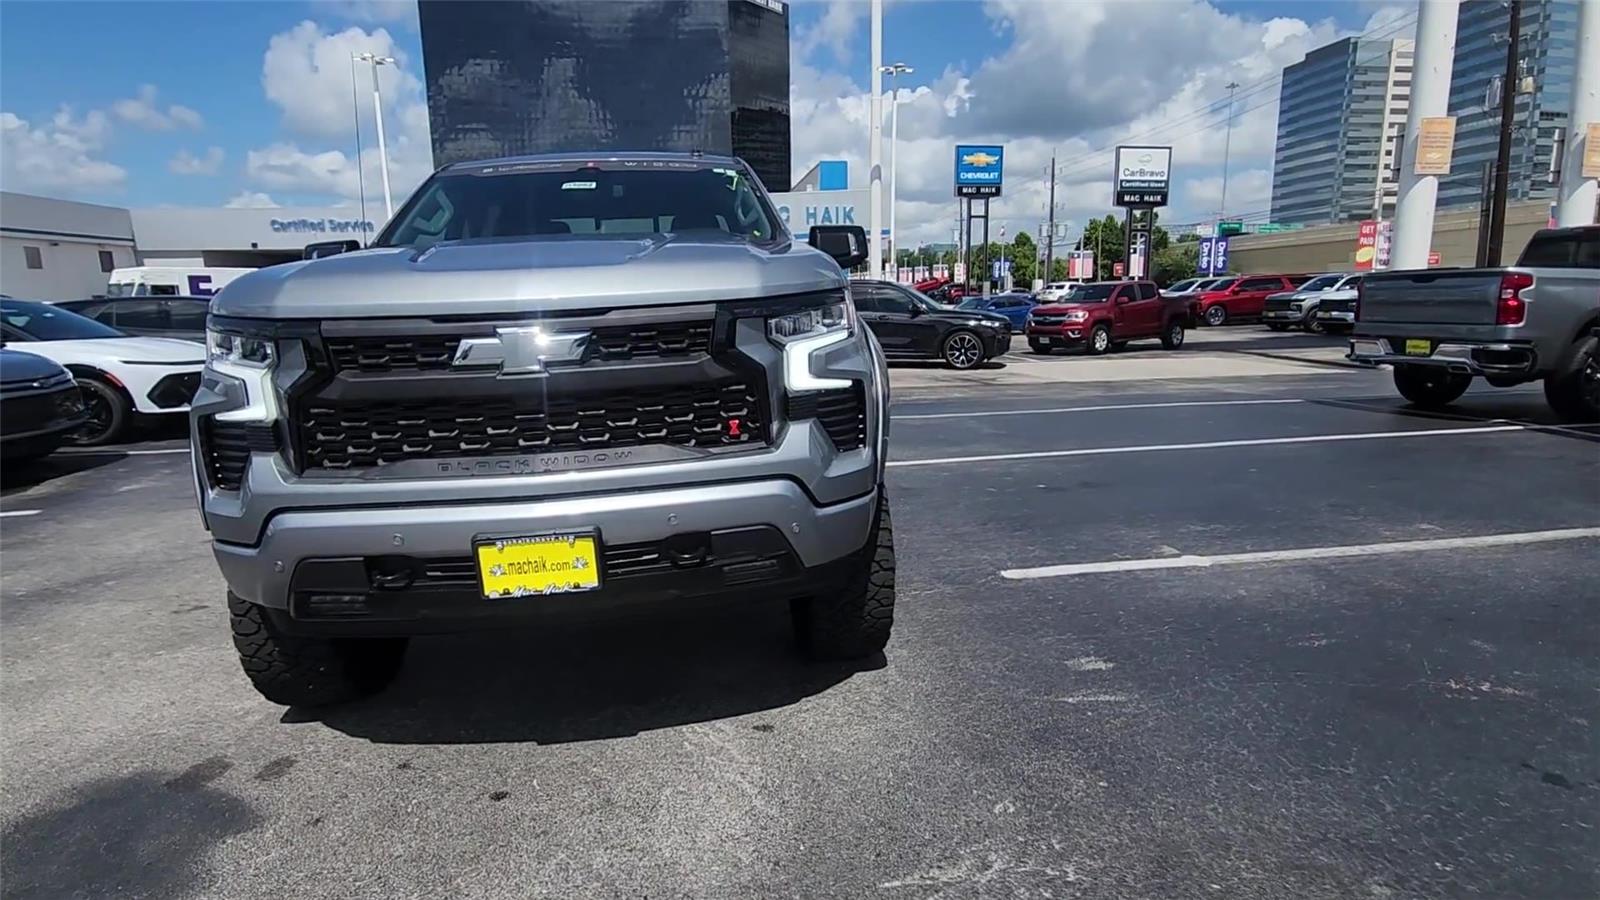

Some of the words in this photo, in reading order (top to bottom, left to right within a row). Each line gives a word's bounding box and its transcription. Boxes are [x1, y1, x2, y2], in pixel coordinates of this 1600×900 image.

[1123, 168, 1166, 177] CarBravo
[1123, 194, 1140, 202] MAC
[1143, 194, 1162, 202] HAIK
[805, 206, 855, 225] HAIK
[270, 219, 326, 233] Certified
[328, 219, 375, 233] Service
[1361, 225, 1375, 234] GET
[1359, 236, 1374, 245] PAID
[437, 458, 531, 473] BLACK
[540, 451, 633, 467] WIDOW
[507, 556, 571, 575] machaik.com
[512, 584, 538, 598] Mac
